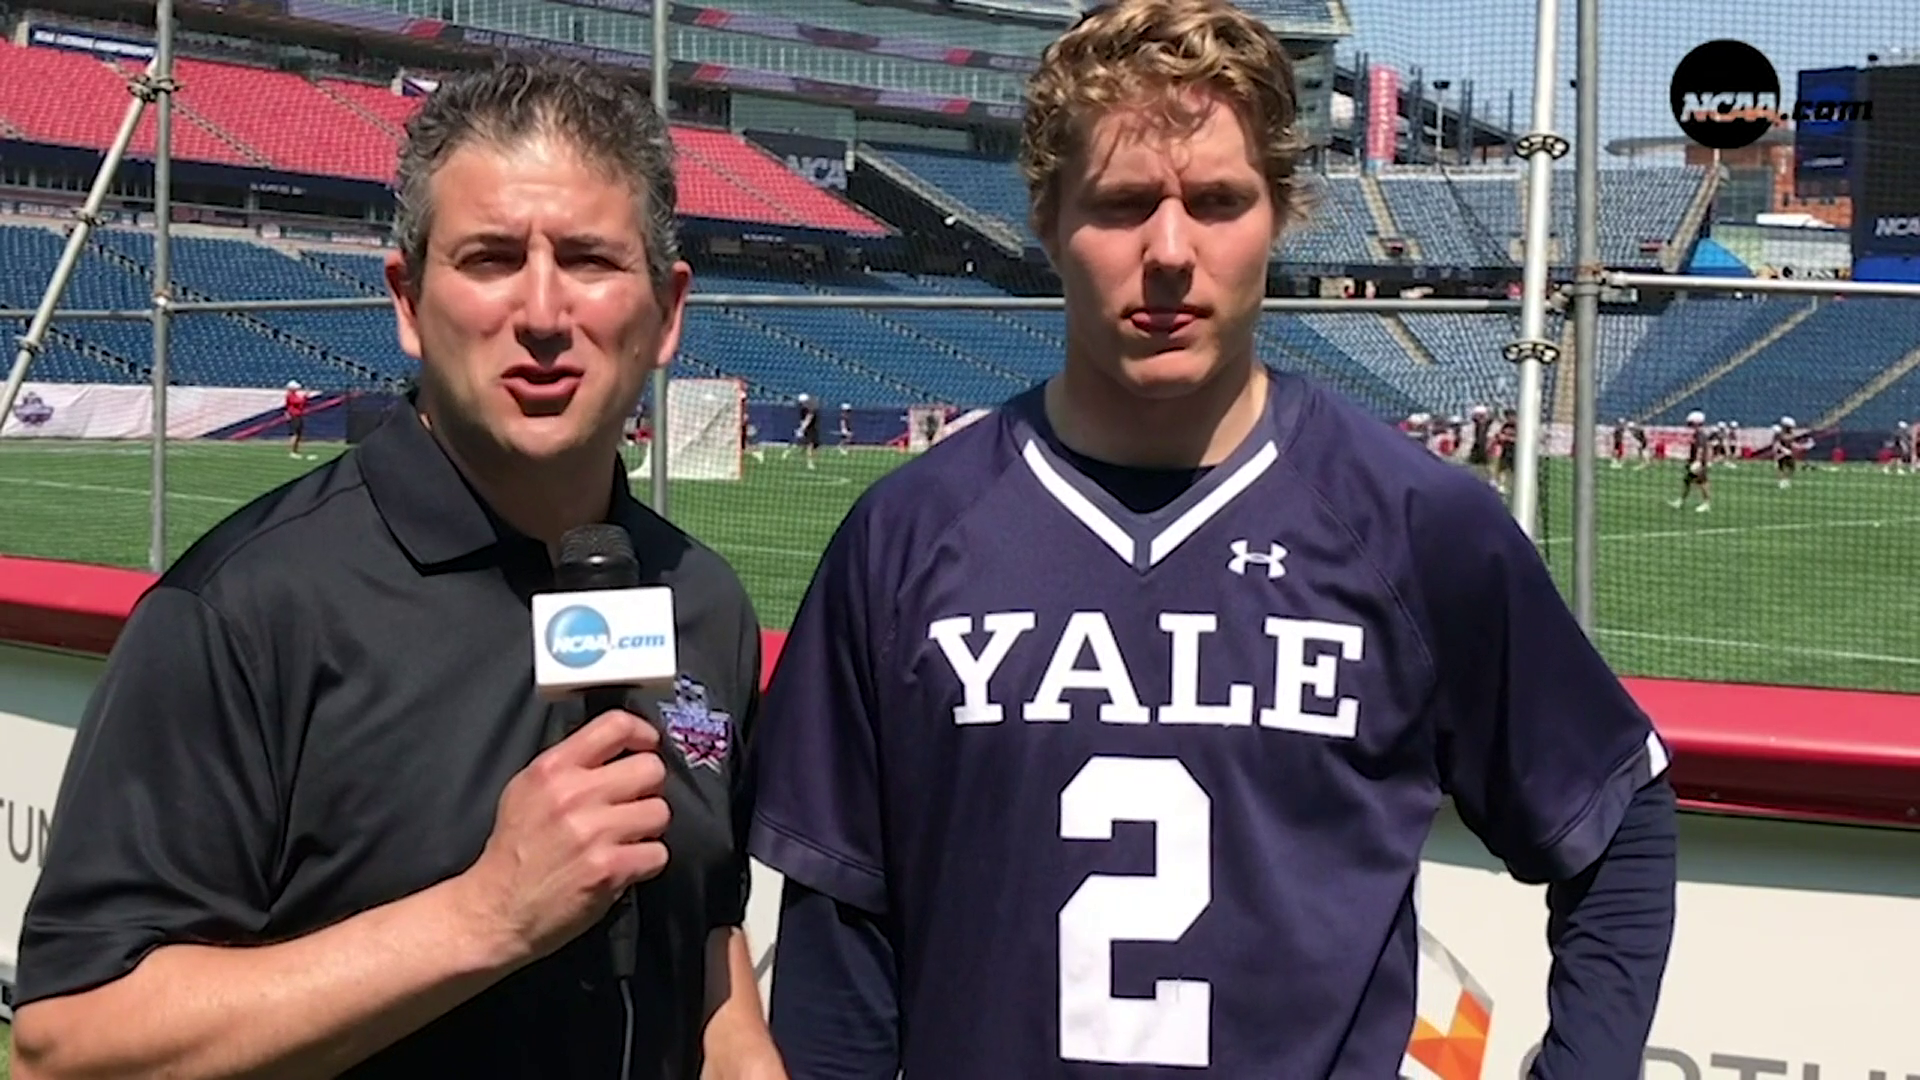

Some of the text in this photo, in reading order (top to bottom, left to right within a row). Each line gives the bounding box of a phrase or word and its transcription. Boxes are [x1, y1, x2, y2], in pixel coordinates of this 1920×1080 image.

[551, 632, 666, 655] NCAA.com
[928, 611, 1364, 738] YALE
[1057, 755, 1212, 1068] 2
